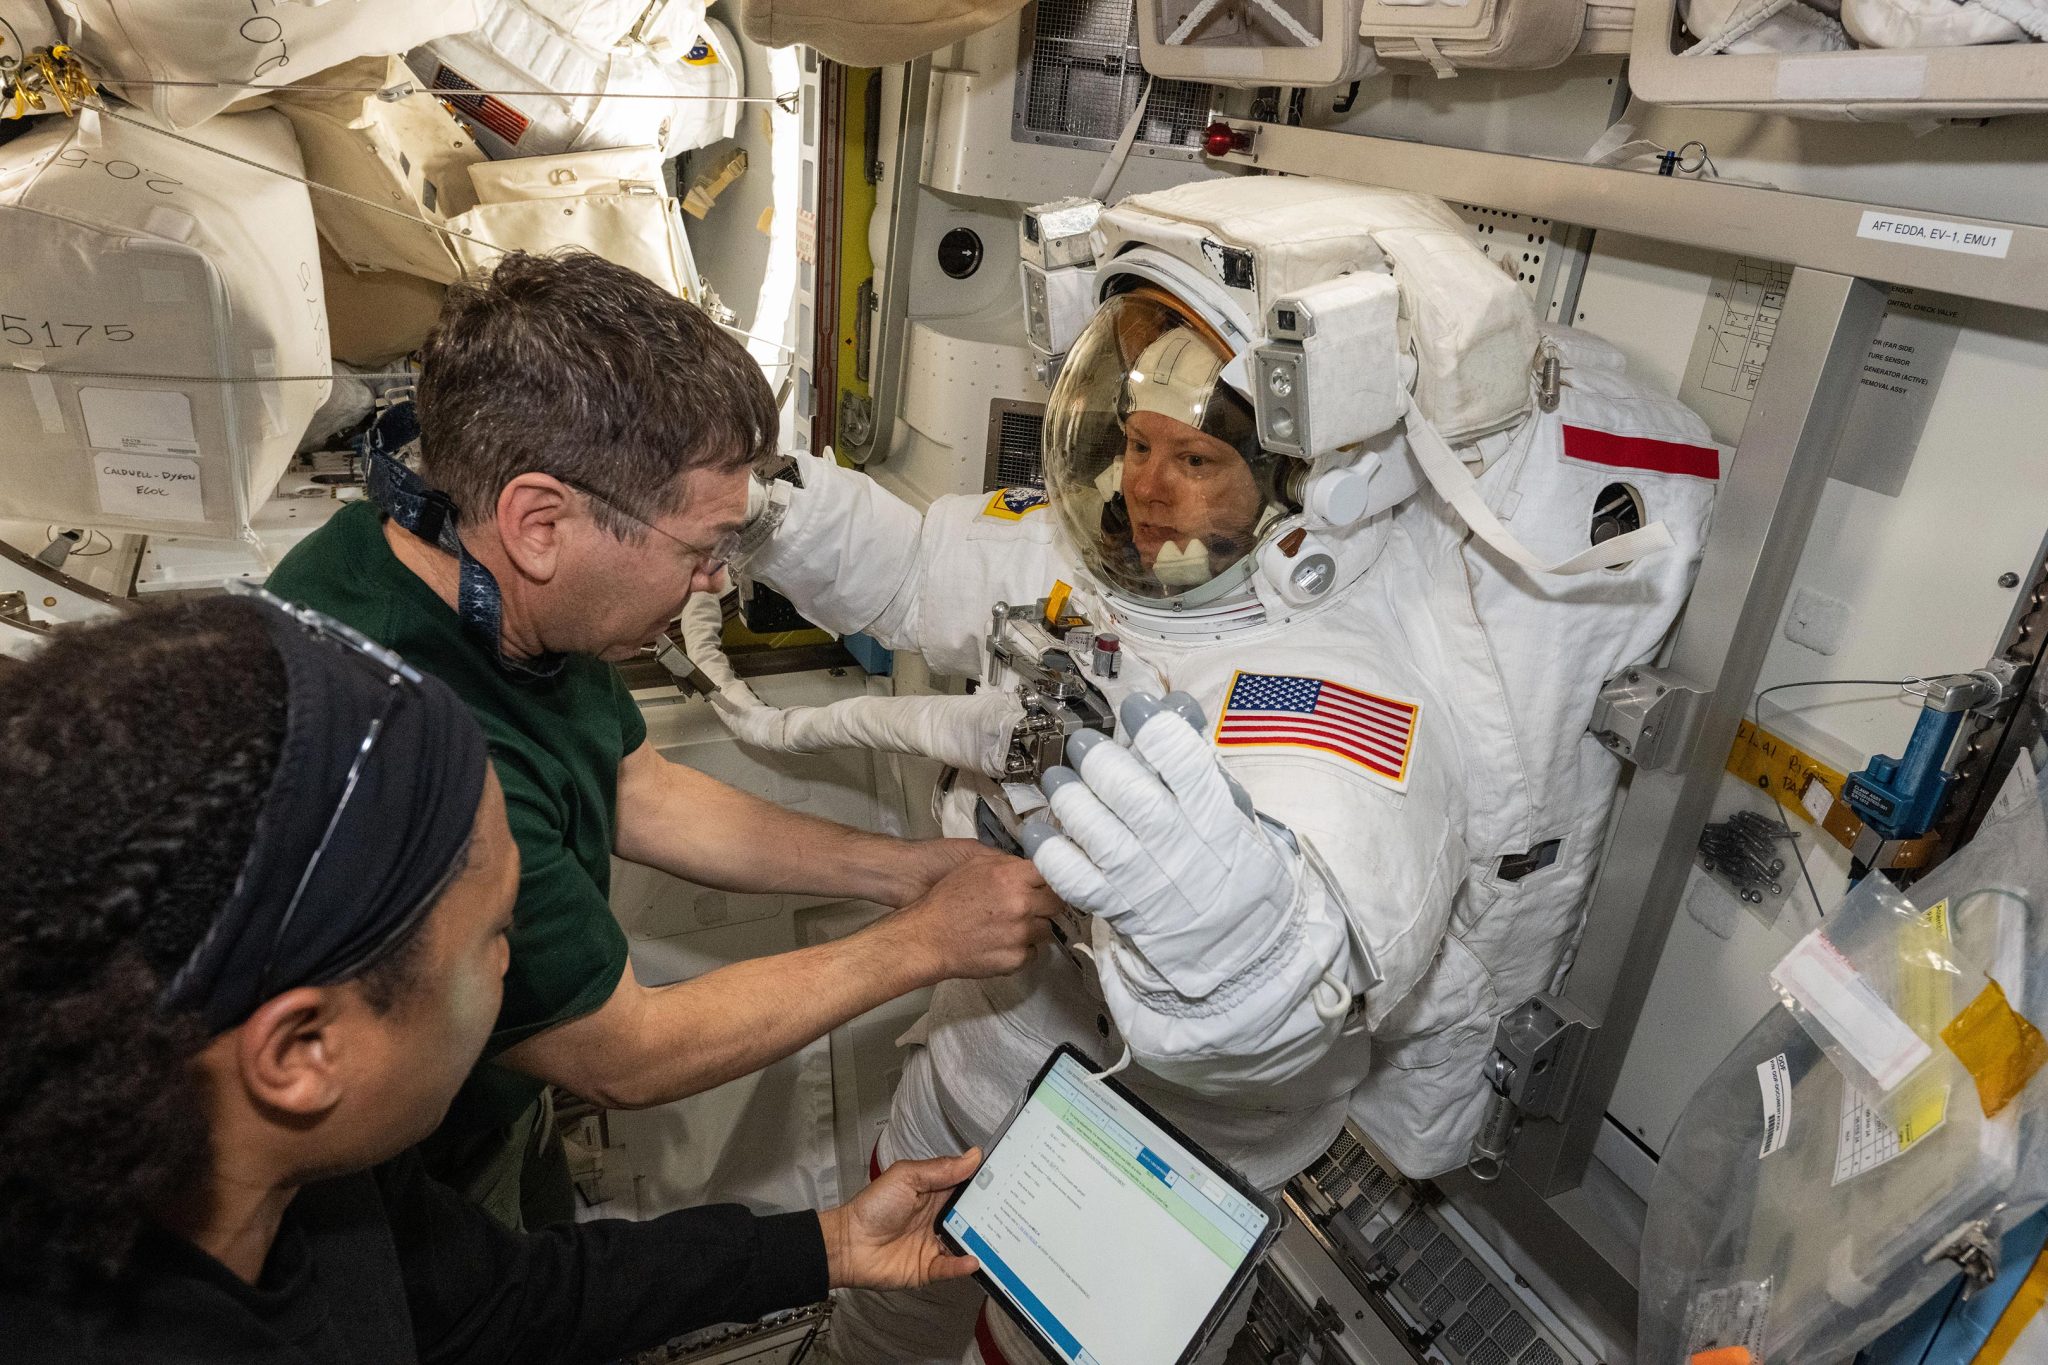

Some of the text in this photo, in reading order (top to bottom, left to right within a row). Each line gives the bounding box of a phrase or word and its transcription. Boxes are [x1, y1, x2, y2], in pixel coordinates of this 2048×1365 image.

[1872, 220, 1998, 247] AFT EDDA, EV-1, EMU1
[1889, 285, 1914, 295] ENSOR
[1913, 304, 1936, 315] CHECK
[1, 314, 134, 348] 5175
[1882, 341, 1897, 349] (FAR
[1897, 344, 1915, 354] SIDE)
[1883, 355, 1911, 366] SENSOR
[1863, 364, 1928, 386] GENERATOR (ACTIVE)
[1860, 378, 1908, 394] REMOVAL ASSY
[1779, 1055, 1787, 1071] ODF
